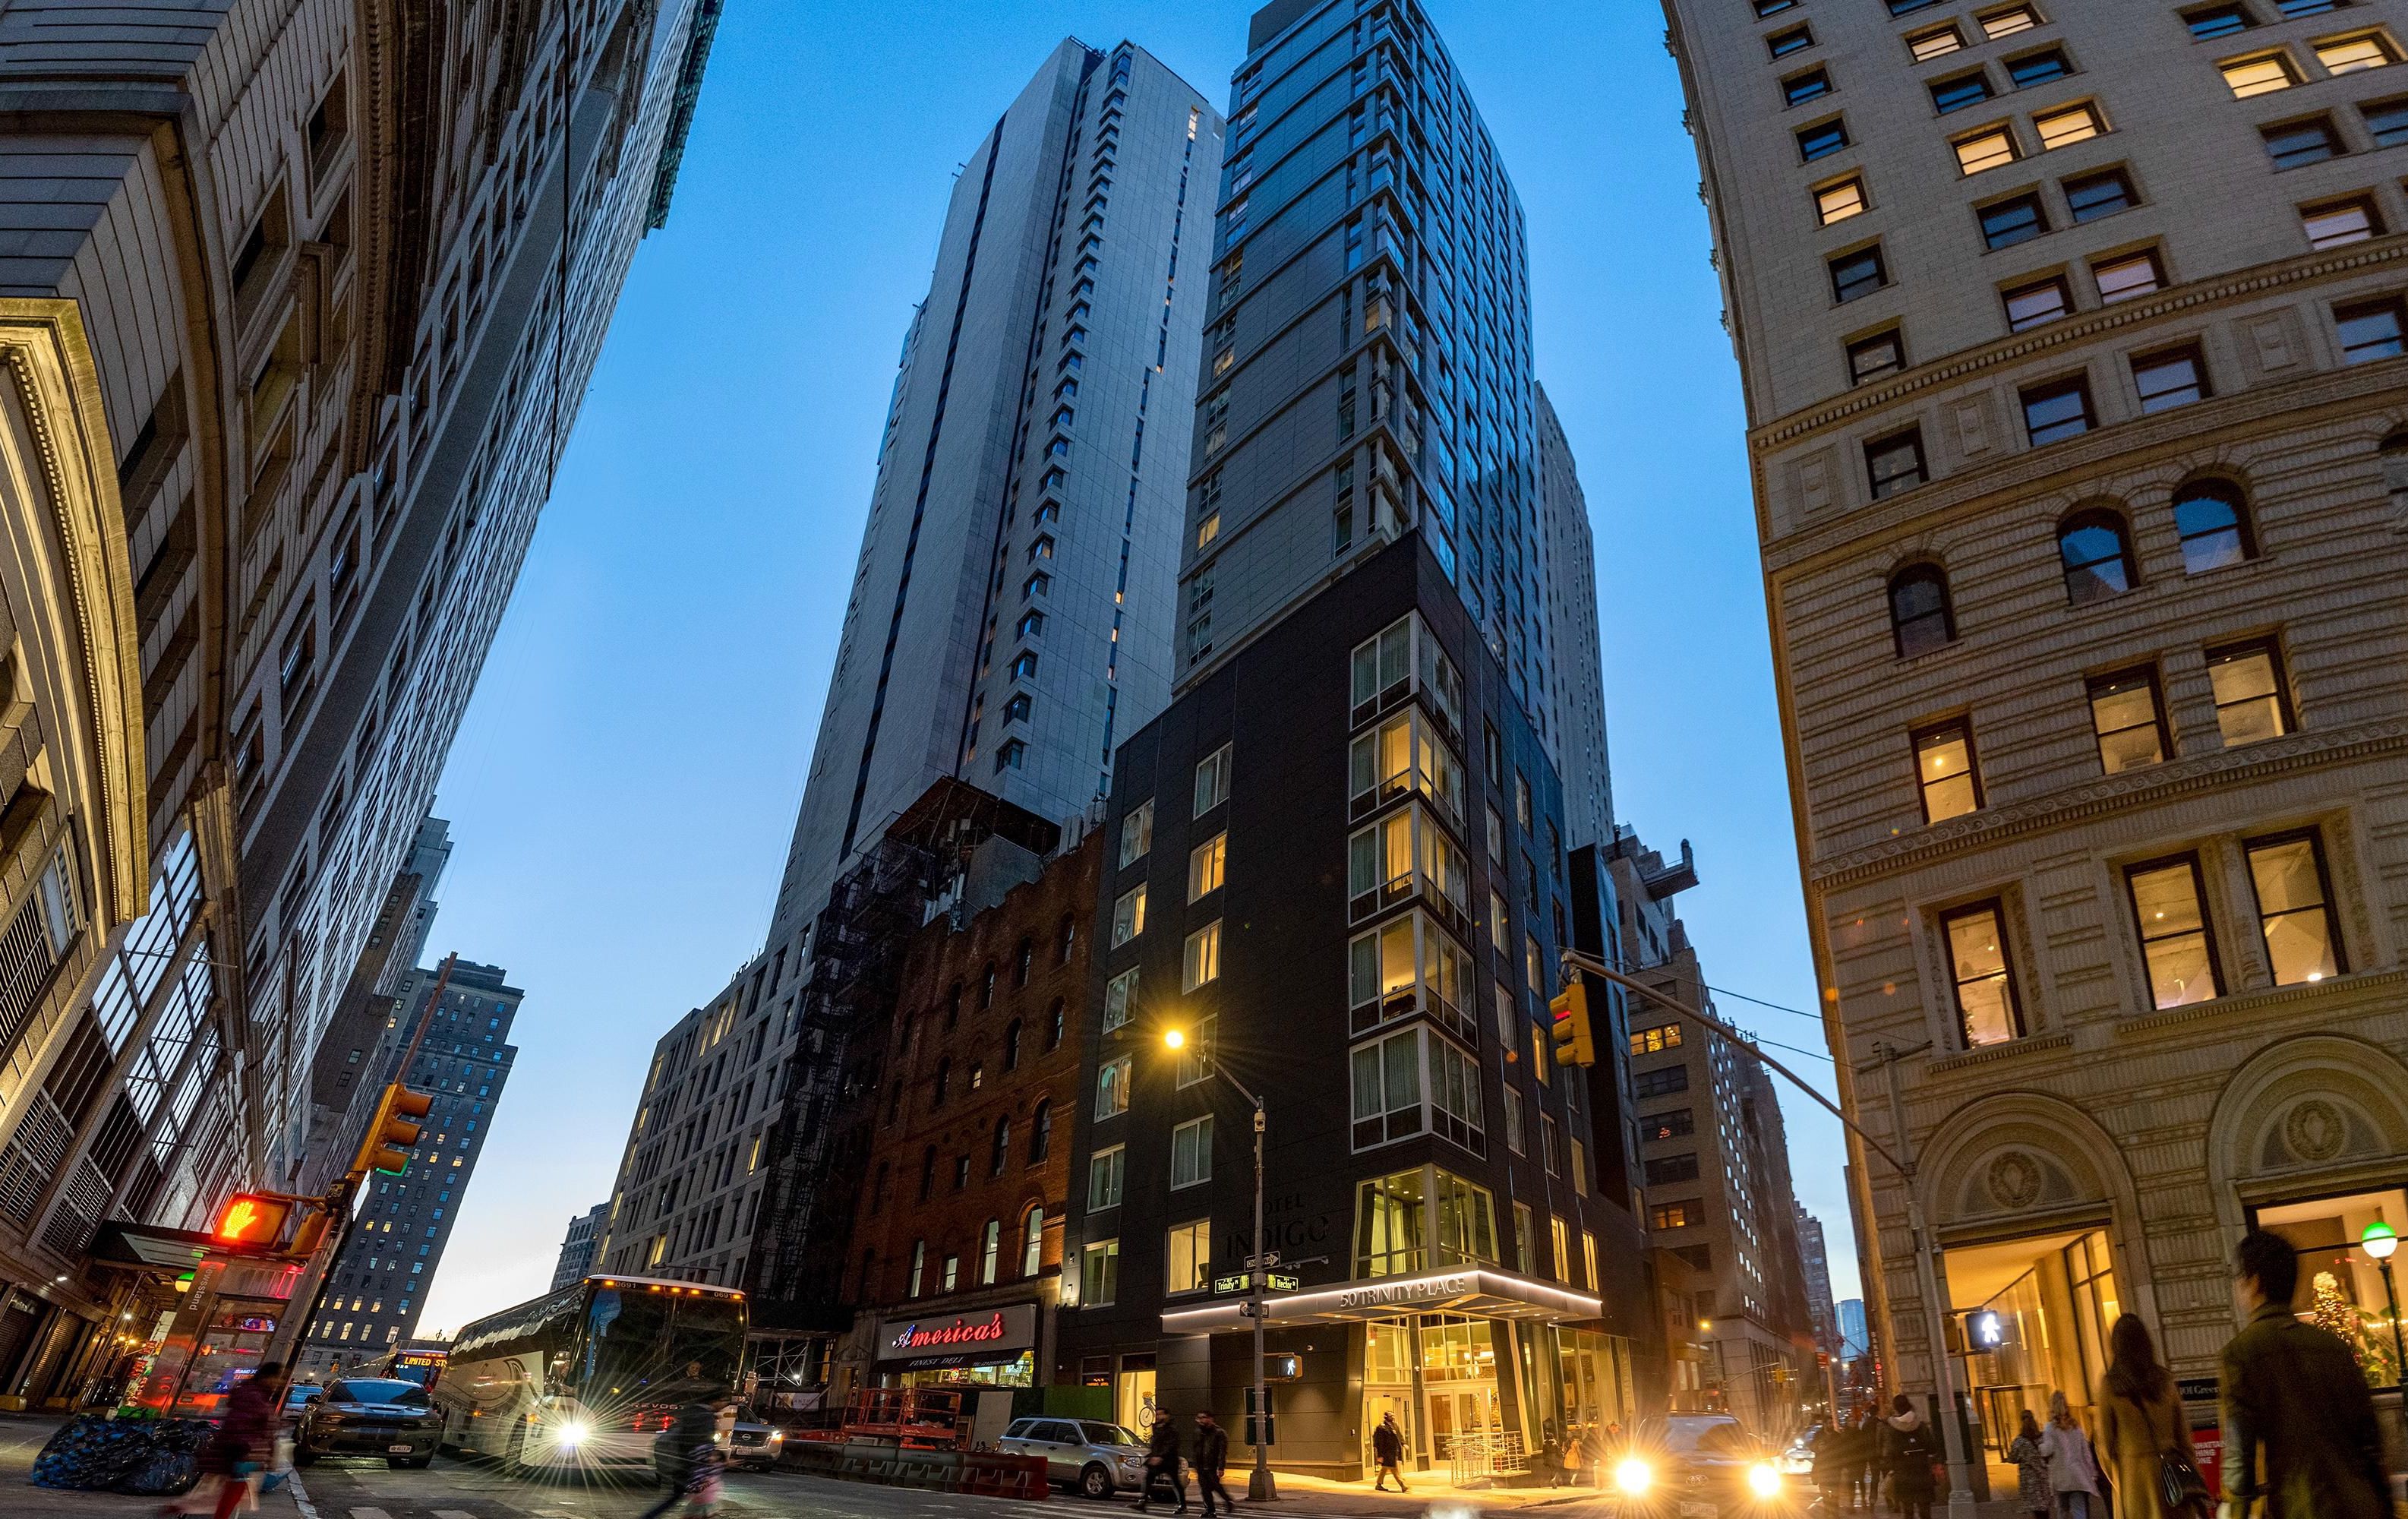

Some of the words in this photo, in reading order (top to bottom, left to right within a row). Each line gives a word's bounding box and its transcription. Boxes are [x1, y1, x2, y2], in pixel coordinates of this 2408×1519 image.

[1227, 1215, 1328, 1258] INDIGO
[188, 1263, 217, 1311] Newsstand
[1217, 1282, 1235, 1291] Trinity
[1277, 1278, 1292, 1290] Rector
[1340, 1292, 1357, 1307] 50
[1359, 1284, 1414, 1305] TRINITY
[1417, 1277, 1466, 1298] PLACE
[892, 1312, 1003, 1348] America's
[404, 1356, 432, 1366] LIMITED
[909, 1358, 940, 1367] FINEST
[941, 1356, 964, 1365] DELI
